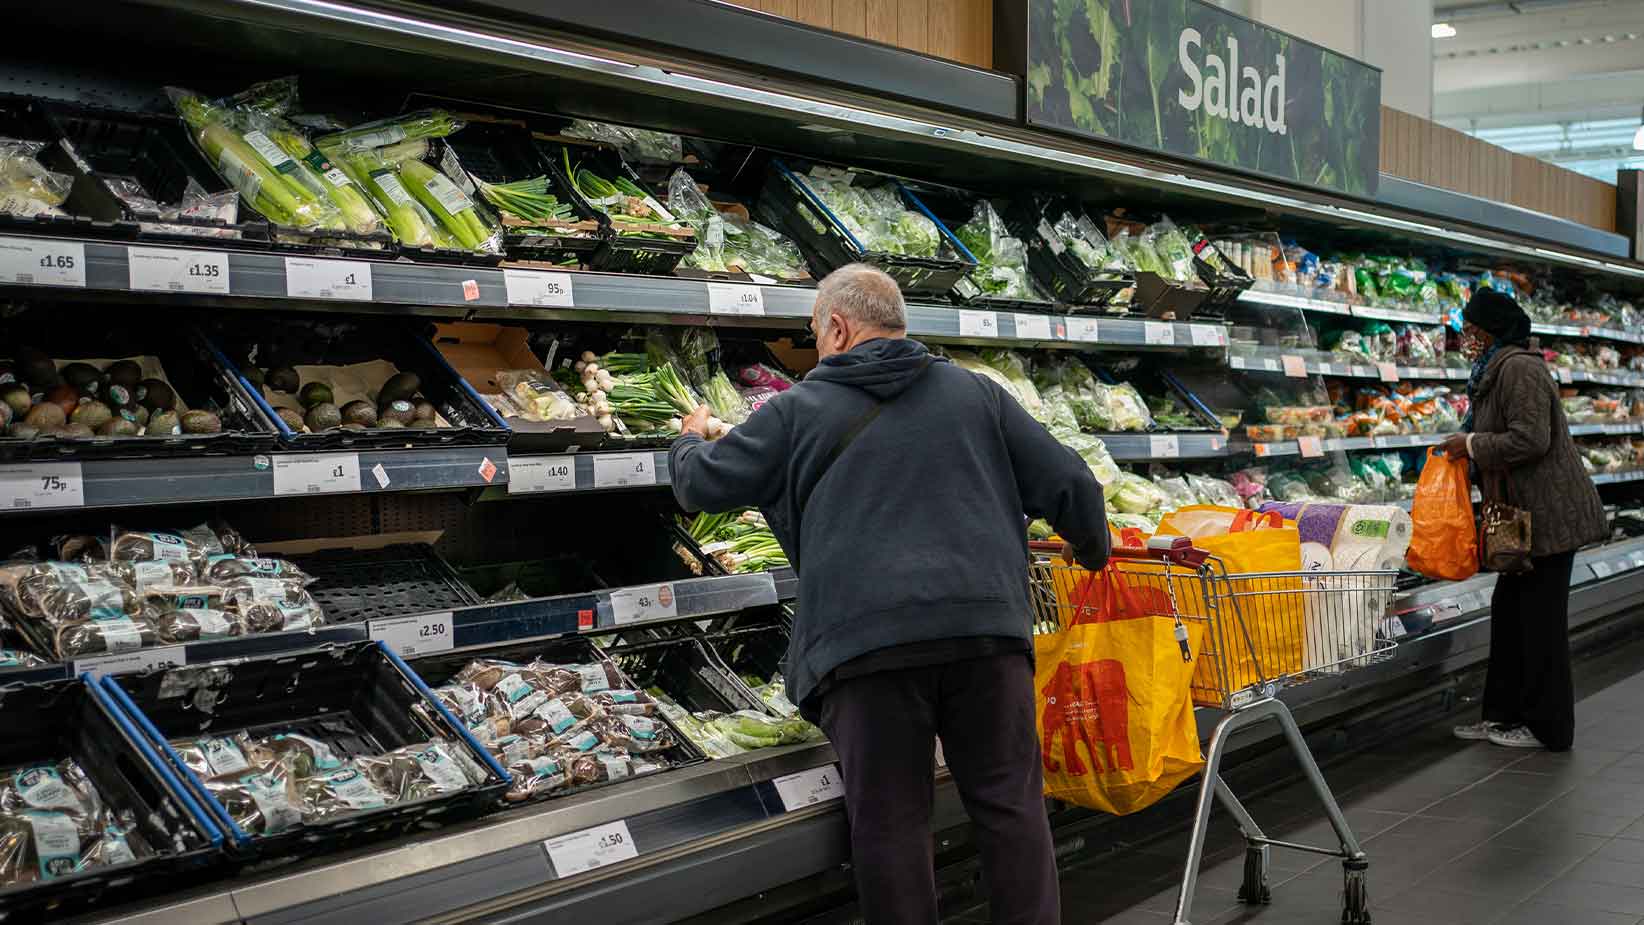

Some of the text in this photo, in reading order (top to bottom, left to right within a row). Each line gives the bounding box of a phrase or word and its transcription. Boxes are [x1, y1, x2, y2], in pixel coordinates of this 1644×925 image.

[1178, 27, 1287, 135] Salad
[40, 254, 74, 269] £1.65
[190, 264, 219, 277] £1.35
[345, 273, 356, 284] £1
[547, 282, 564, 294] 95p
[333, 465, 344, 478] £1
[548, 466, 568, 477] £1.40
[636, 461, 643, 472] £1
[41, 476, 66, 490] 75p
[420, 624, 445, 637] £2.50
[821, 775, 831, 786] £1
[598, 833, 623, 848] £1.50
